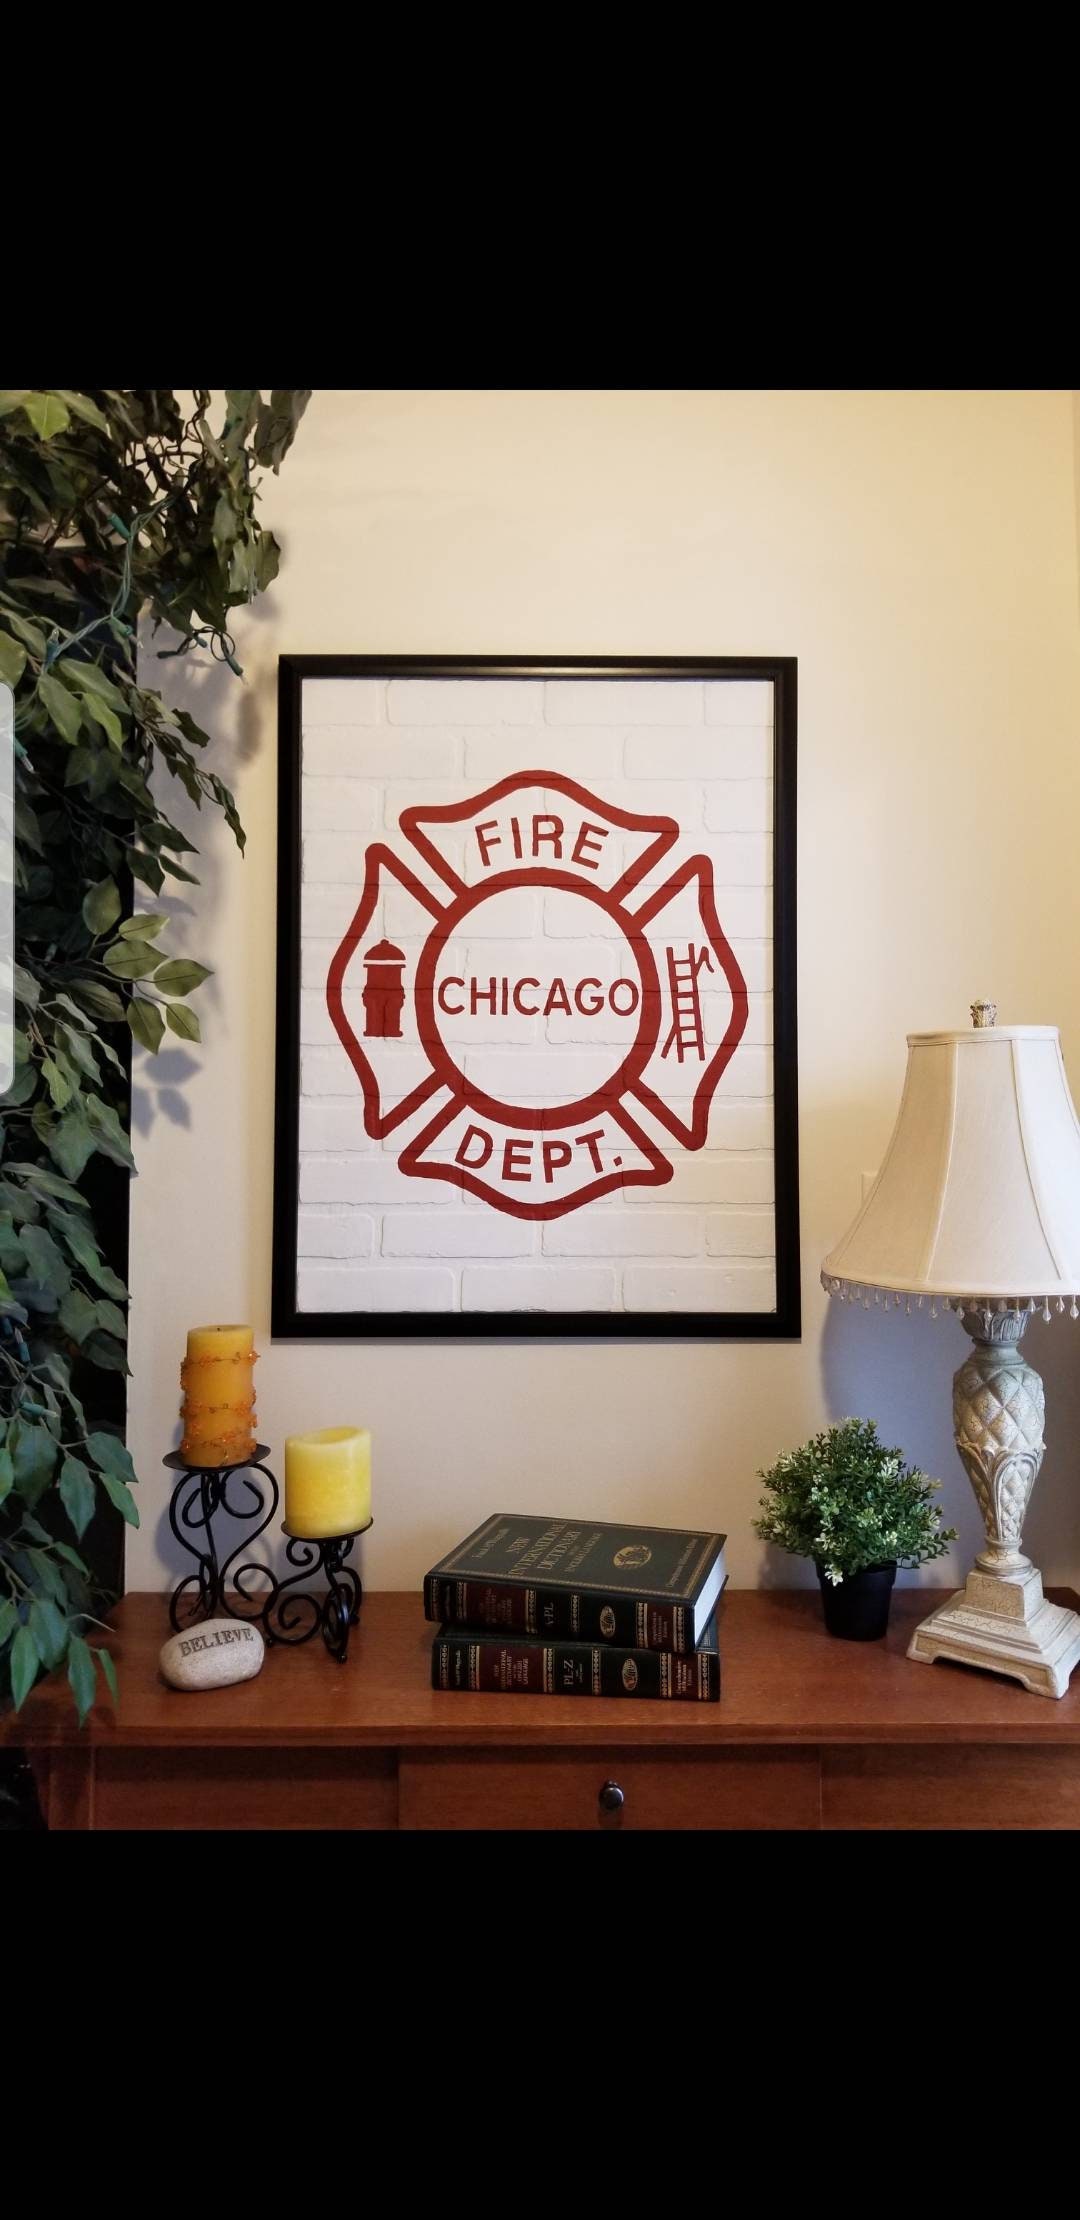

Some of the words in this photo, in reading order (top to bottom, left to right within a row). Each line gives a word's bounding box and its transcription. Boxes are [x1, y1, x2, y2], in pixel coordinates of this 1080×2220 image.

[475, 815, 608, 869] FIRE
[438, 977, 640, 1017] CHICAGO
[455, 1124, 623, 1184] DEPT.
[179, 1628, 254, 1657] BELIEVE
[564, 1660, 574, 1685] PL-Z
